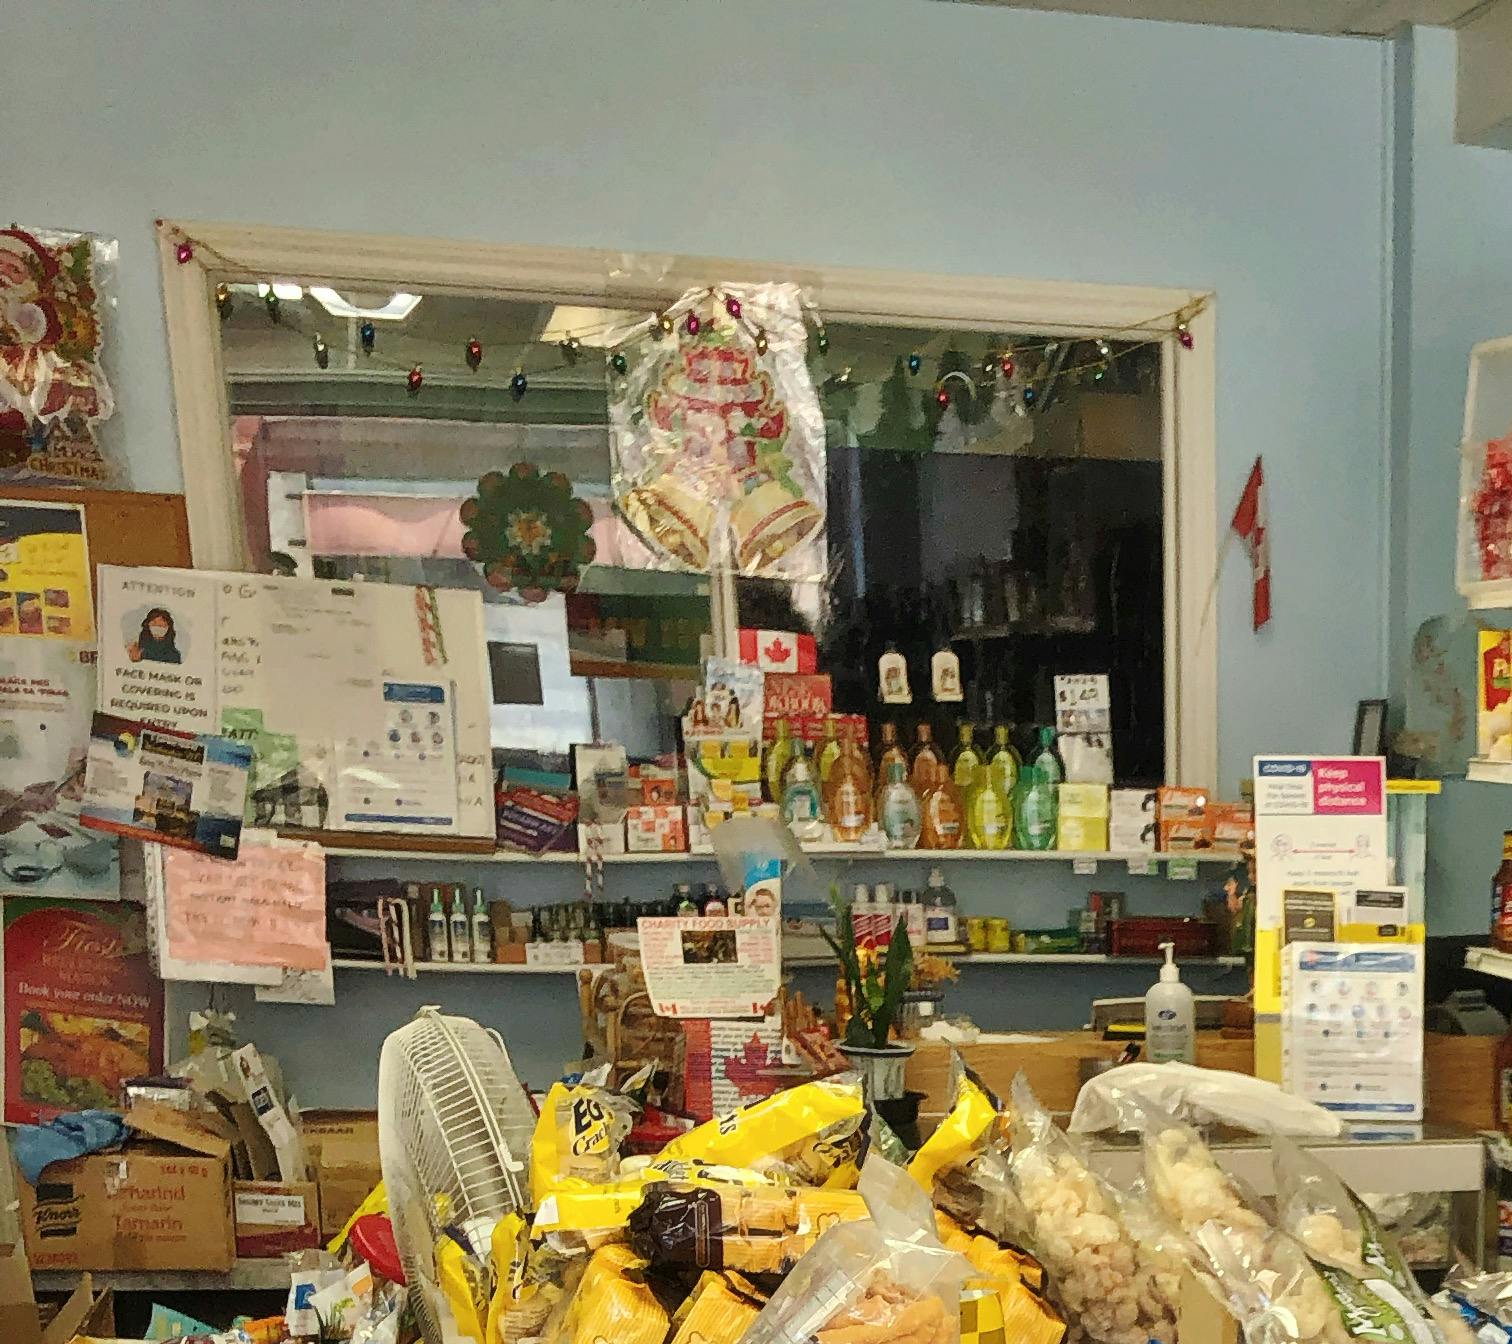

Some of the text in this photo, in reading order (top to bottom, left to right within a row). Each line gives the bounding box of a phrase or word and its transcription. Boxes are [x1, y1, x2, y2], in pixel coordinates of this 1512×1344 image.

[122, 580, 196, 599] ATTENTION
[115, 666, 145, 682] FACE
[149, 668, 182, 685] MASK
[121, 683, 181, 700] COVERING
[111, 697, 208, 719] REQUIRED UPON
[1318, 766, 1348, 784] Keep
[1317, 780, 1366, 798] physical
[1317, 794, 1368, 809] distance
[641, 917, 771, 932] CHARITY FOOD SUPPLY
